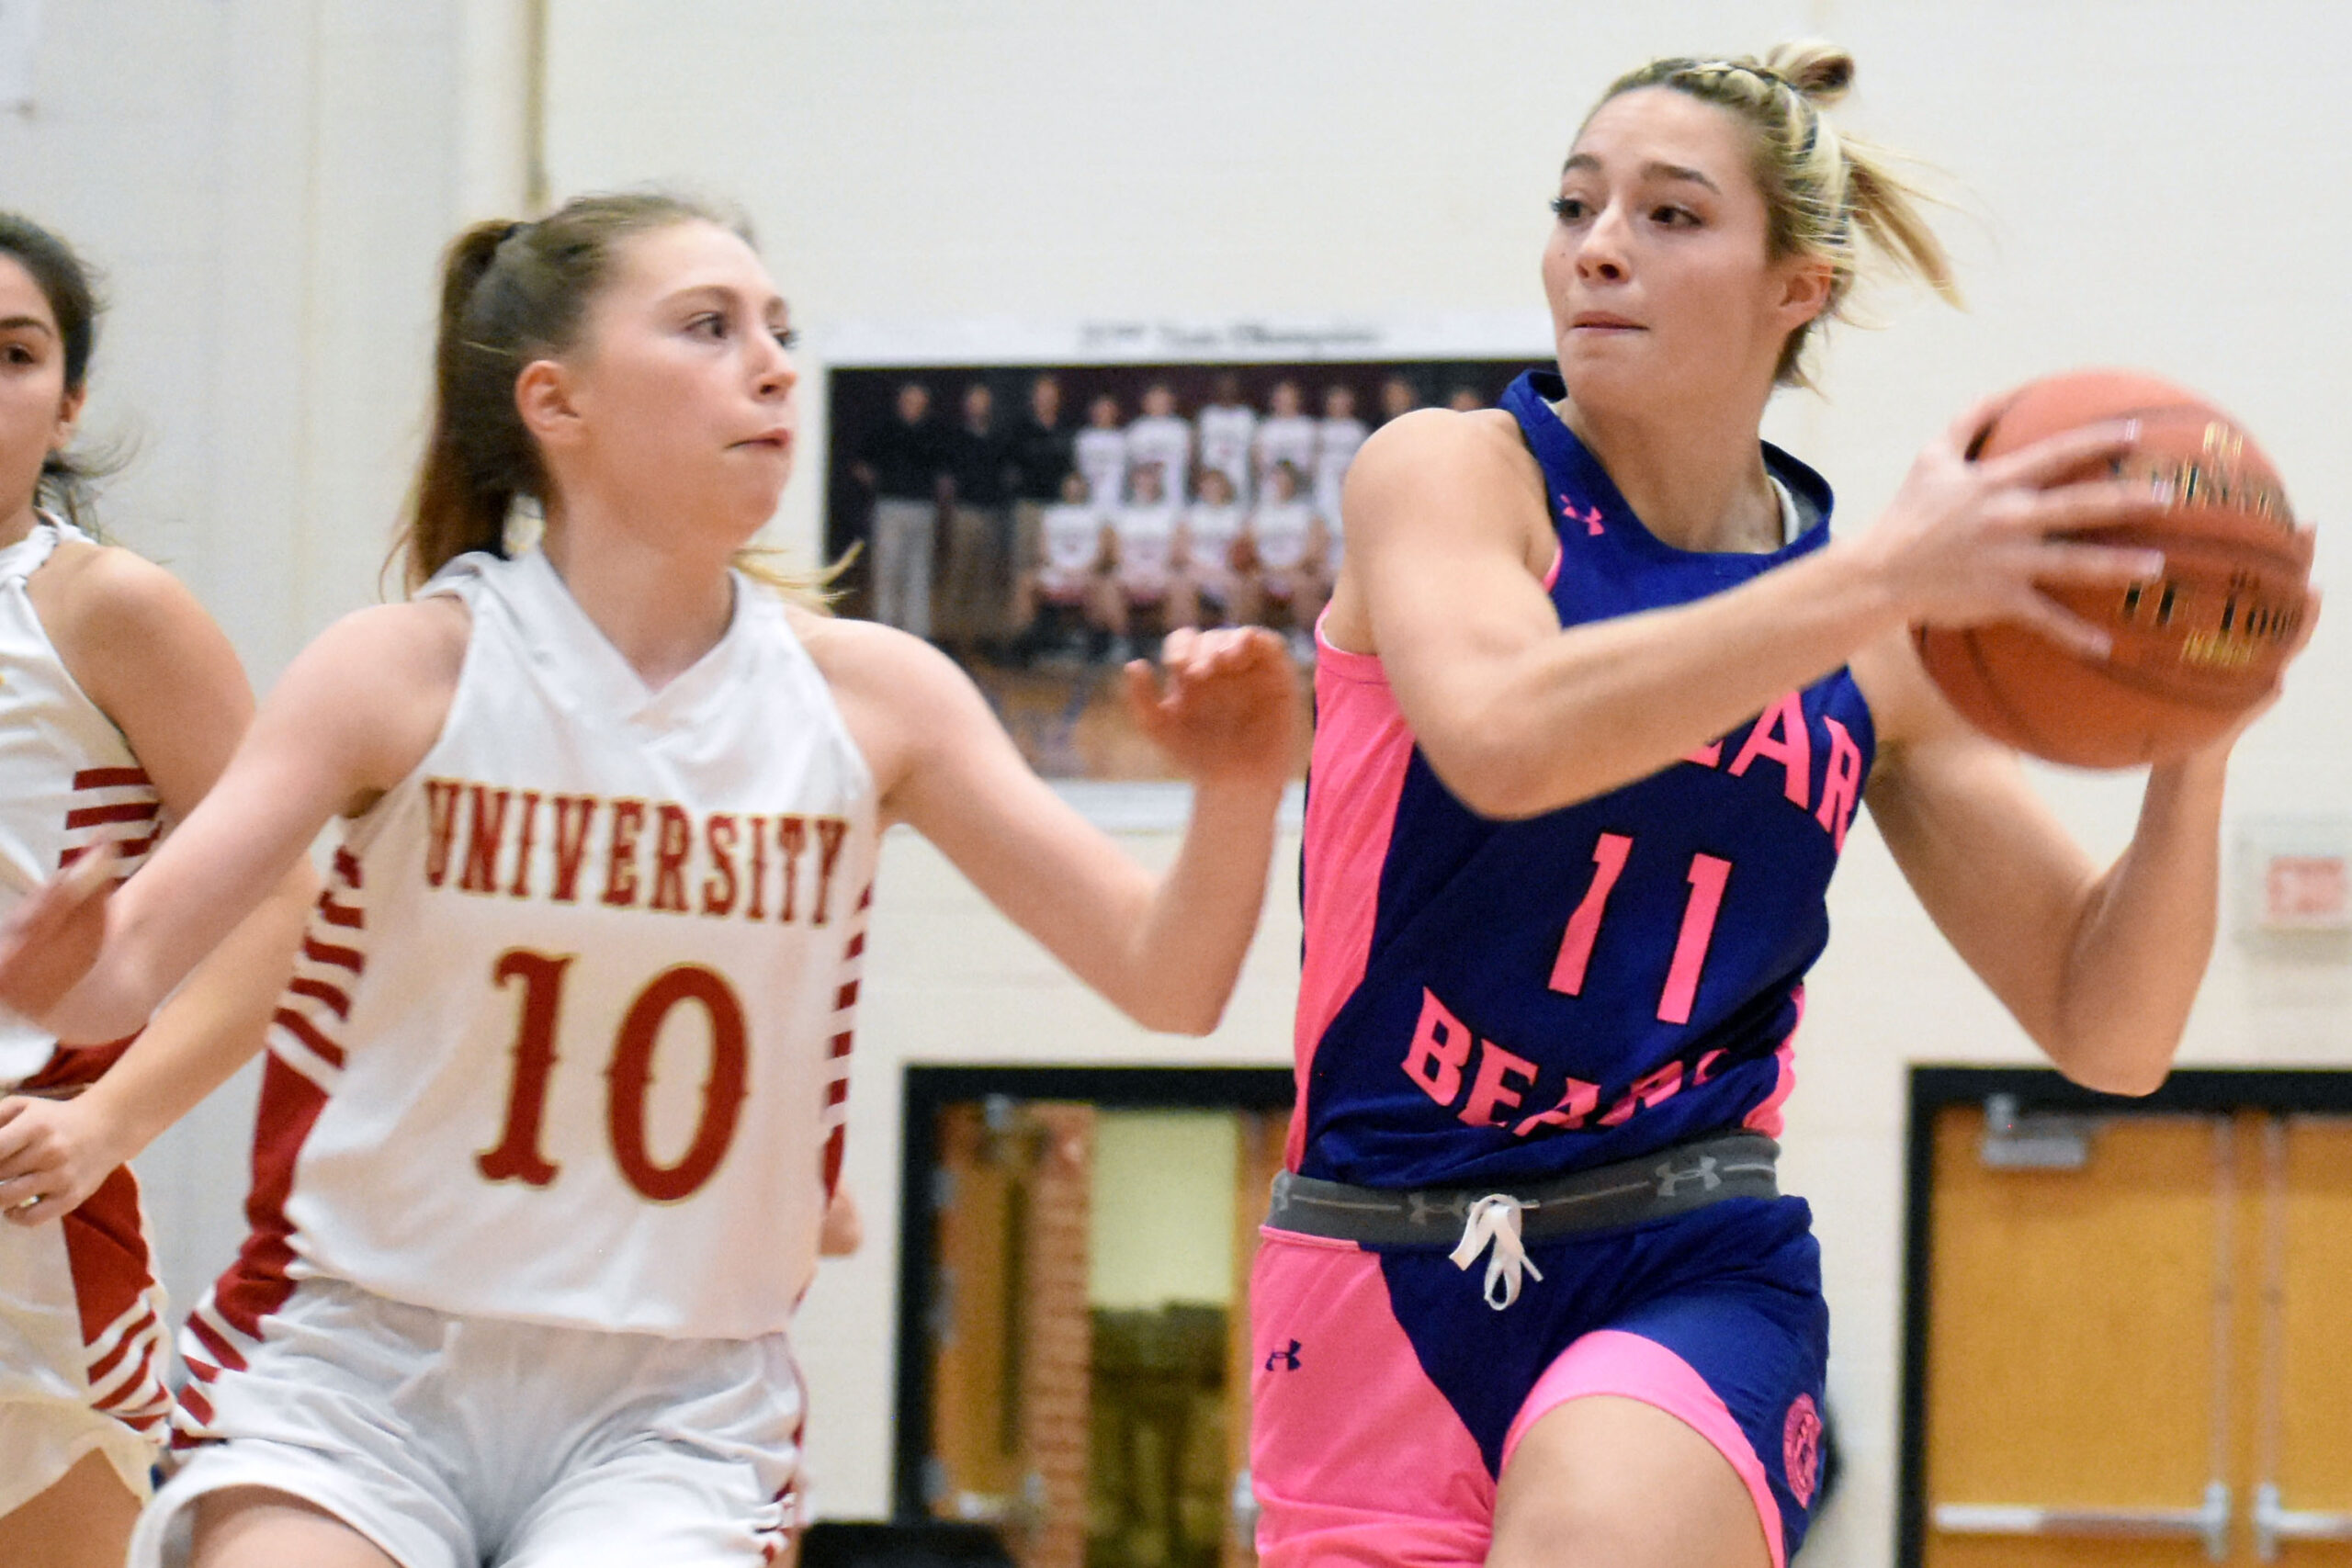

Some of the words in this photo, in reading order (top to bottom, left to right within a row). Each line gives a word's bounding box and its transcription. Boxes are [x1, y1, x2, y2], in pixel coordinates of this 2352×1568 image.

[424, 777, 851, 927] UNIVERSITY
[1682, 691, 1862, 856] AR
[1548, 832, 1733, 1024] 11
[475, 947, 751, 1204] 10
